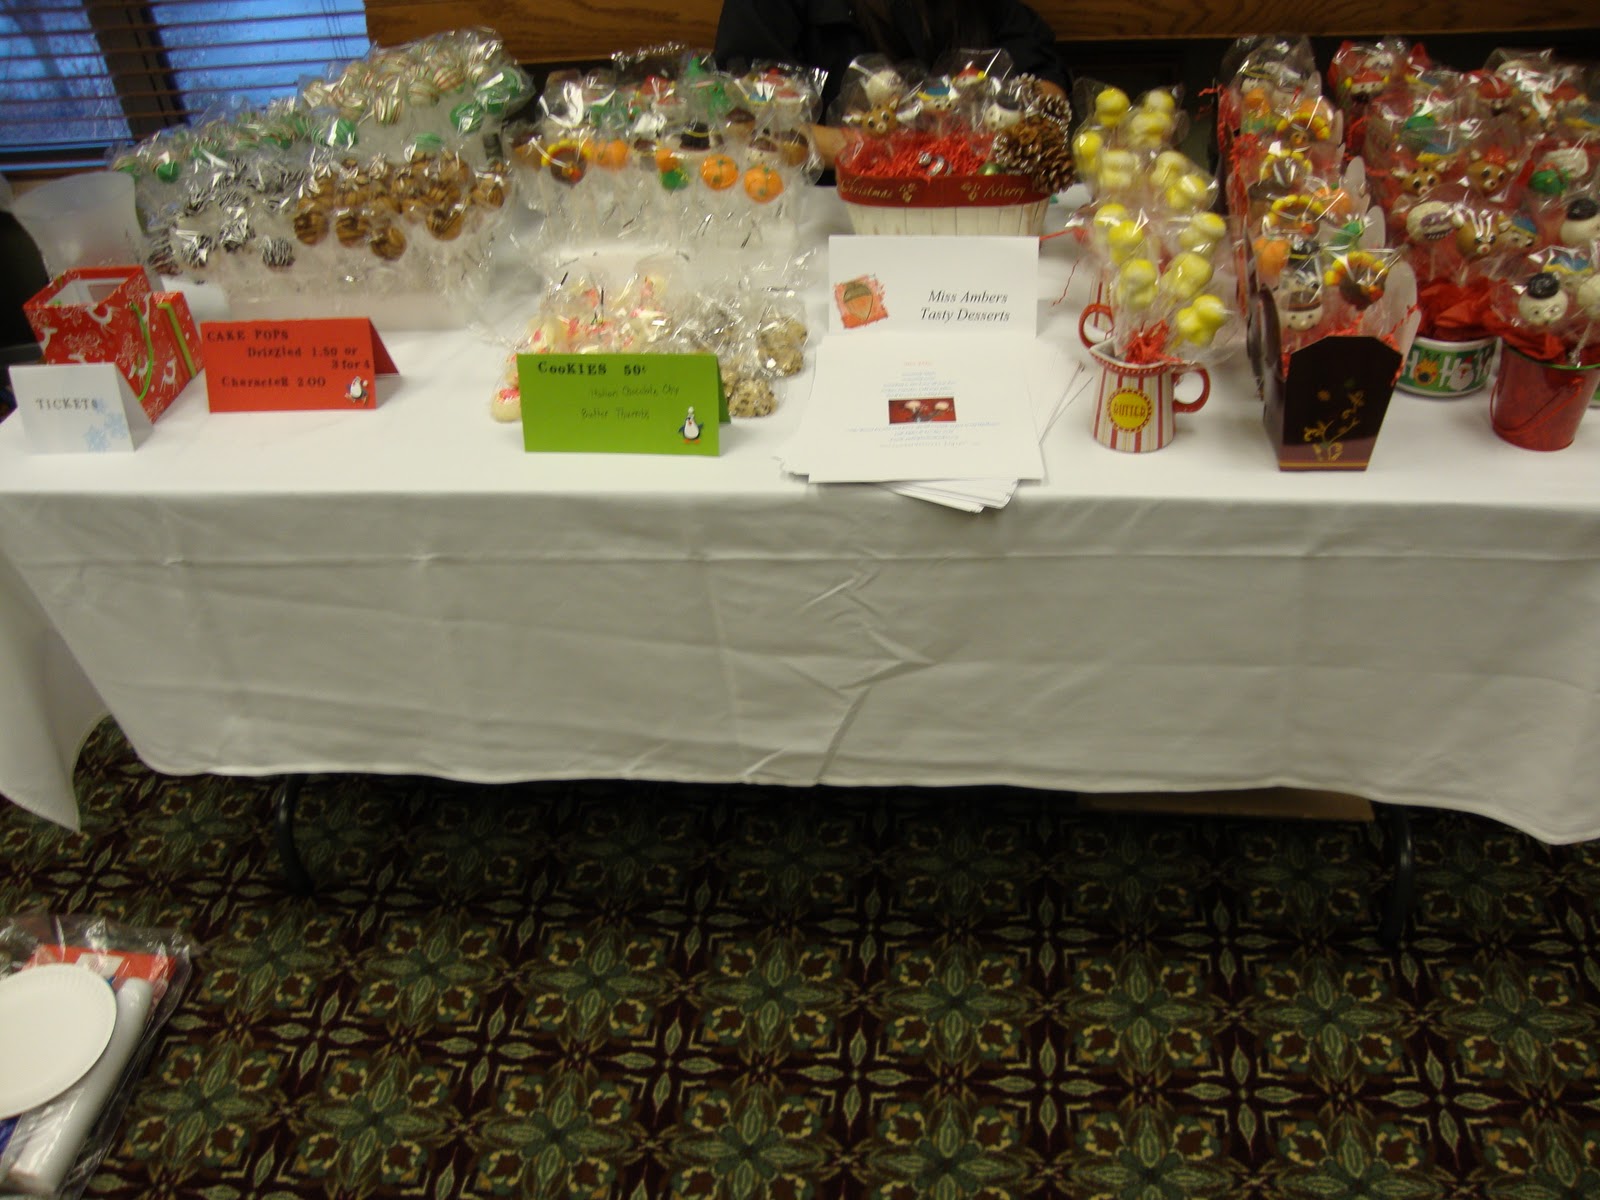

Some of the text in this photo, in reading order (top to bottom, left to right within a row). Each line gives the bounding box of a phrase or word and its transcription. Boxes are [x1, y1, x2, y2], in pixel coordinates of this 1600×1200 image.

[840, 176, 1027, 199] Christmas Merry
[928, 290, 1009, 304] Miss Ambers
[920, 307, 1011, 323] Tasty Desserts
[207, 328, 289, 344] CAKE POPS
[342, 359, 360, 370] for
